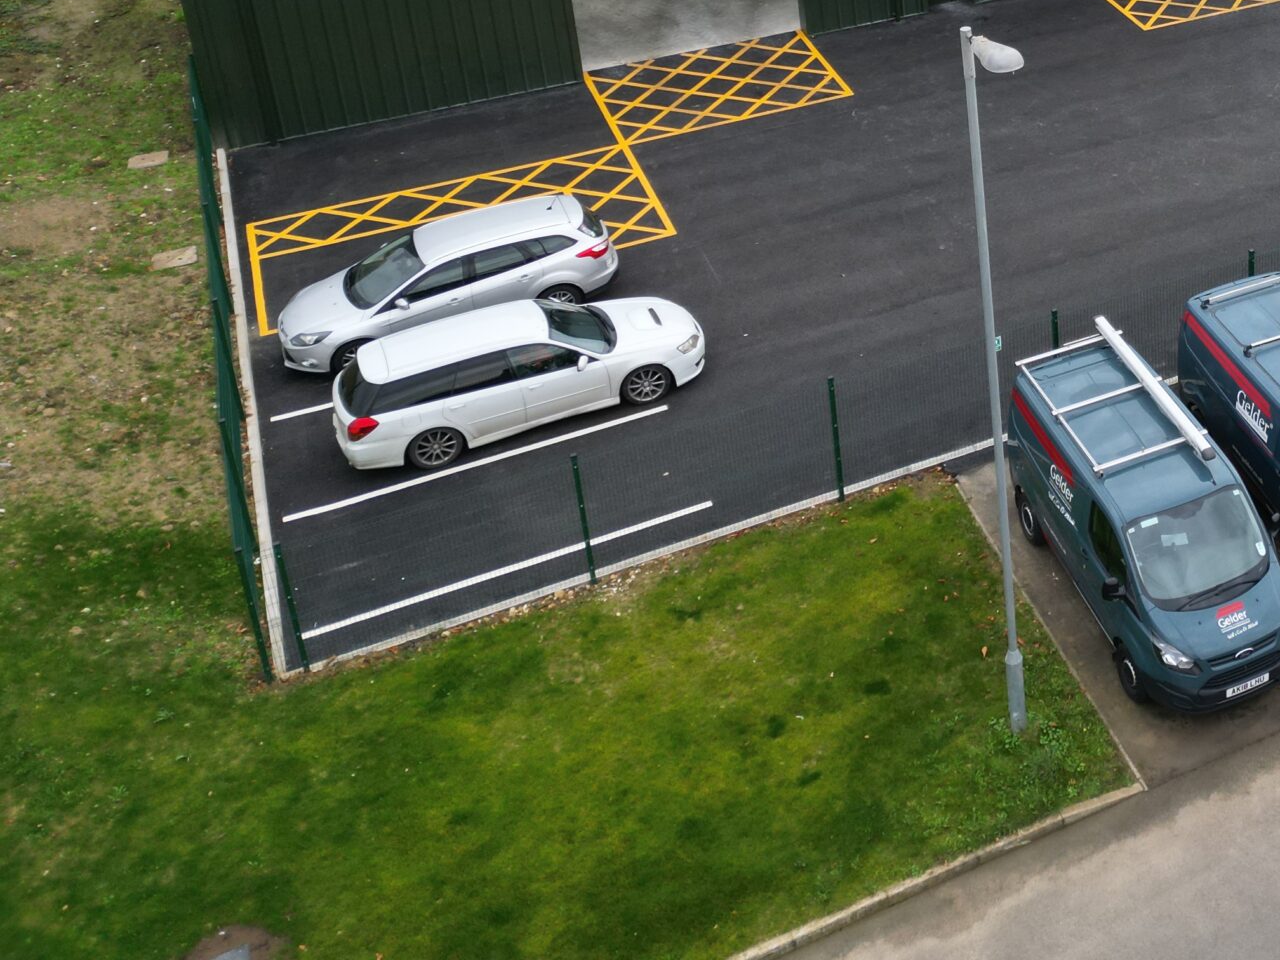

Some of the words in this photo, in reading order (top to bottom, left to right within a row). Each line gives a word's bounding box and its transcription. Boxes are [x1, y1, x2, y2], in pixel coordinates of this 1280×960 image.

[1236, 389, 1270, 434] Gelder
[1049, 463, 1074, 503] Gelder
[1217, 609, 1248, 629] Gelder
